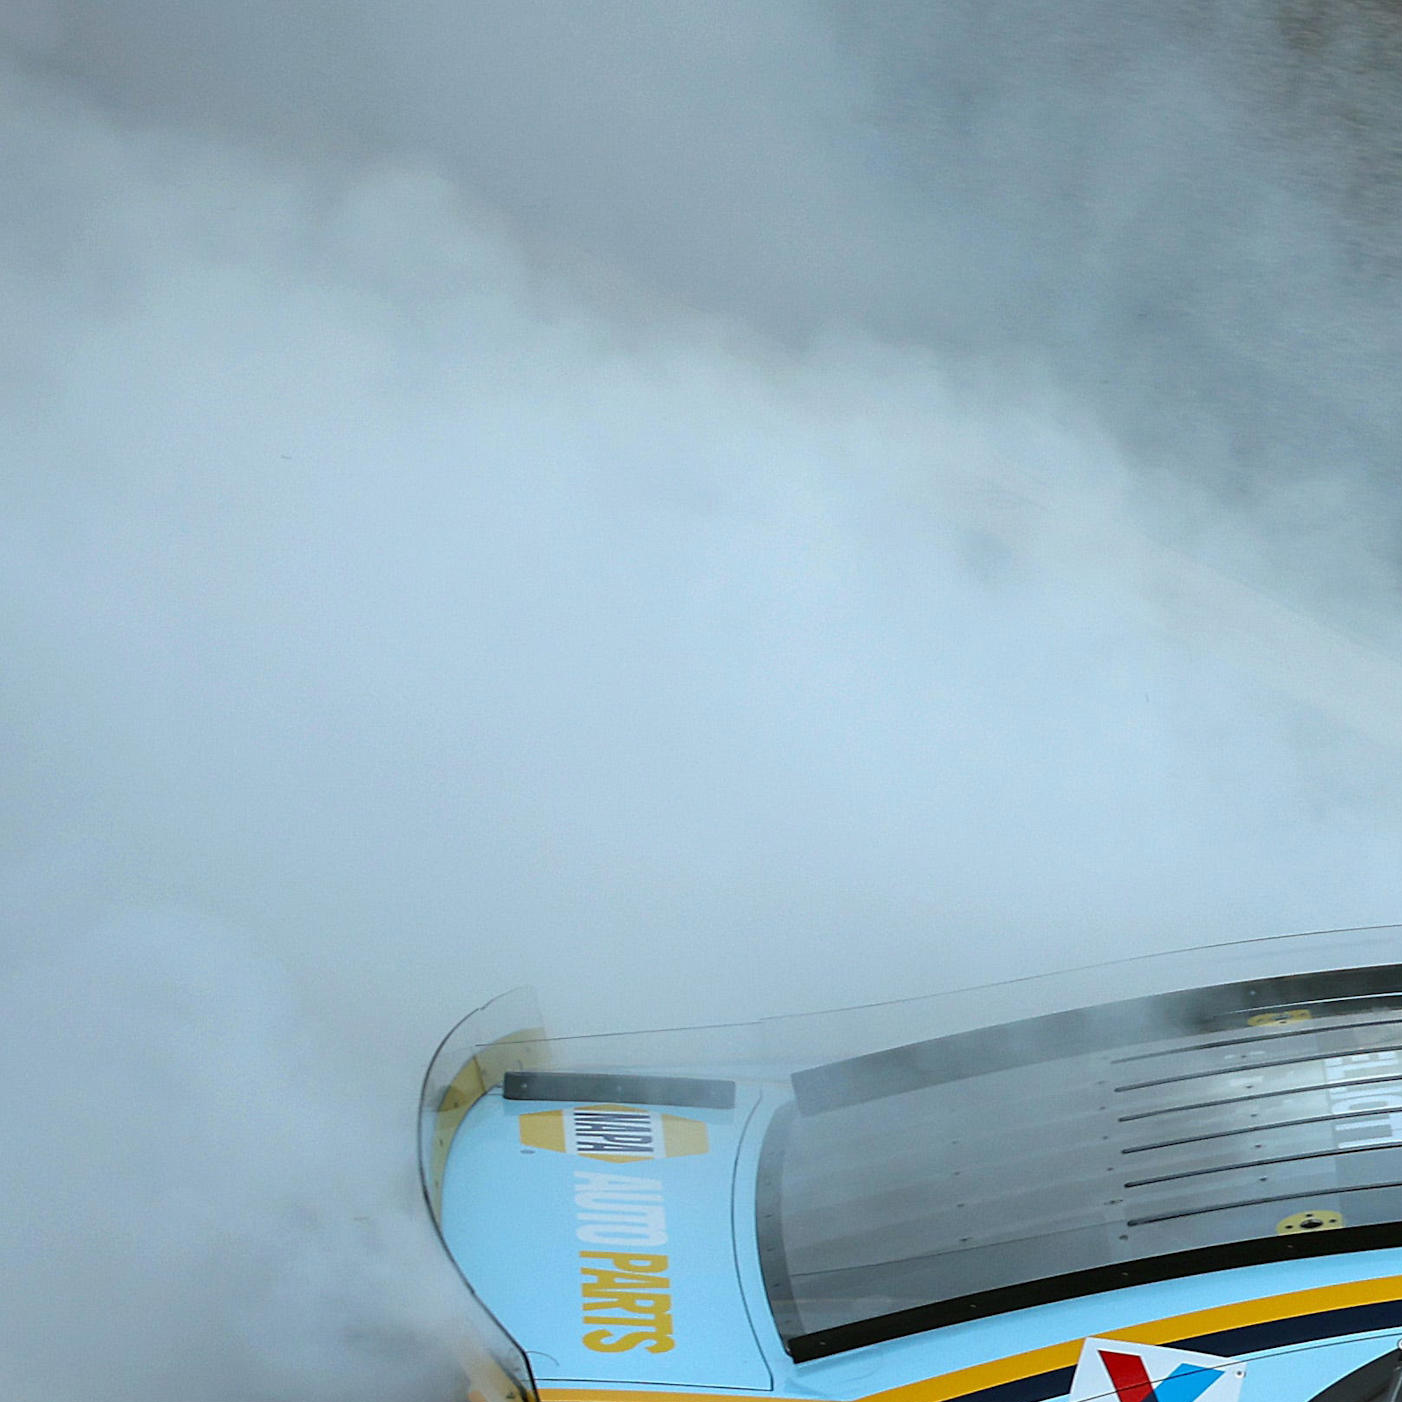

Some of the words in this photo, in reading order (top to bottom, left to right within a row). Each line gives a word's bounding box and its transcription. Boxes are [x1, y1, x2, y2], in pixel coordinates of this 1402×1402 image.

[573, 1111, 655, 1153] NAPA
[572, 1170, 668, 1247] AUTO
[578, 1250, 675, 1355] PARTS
